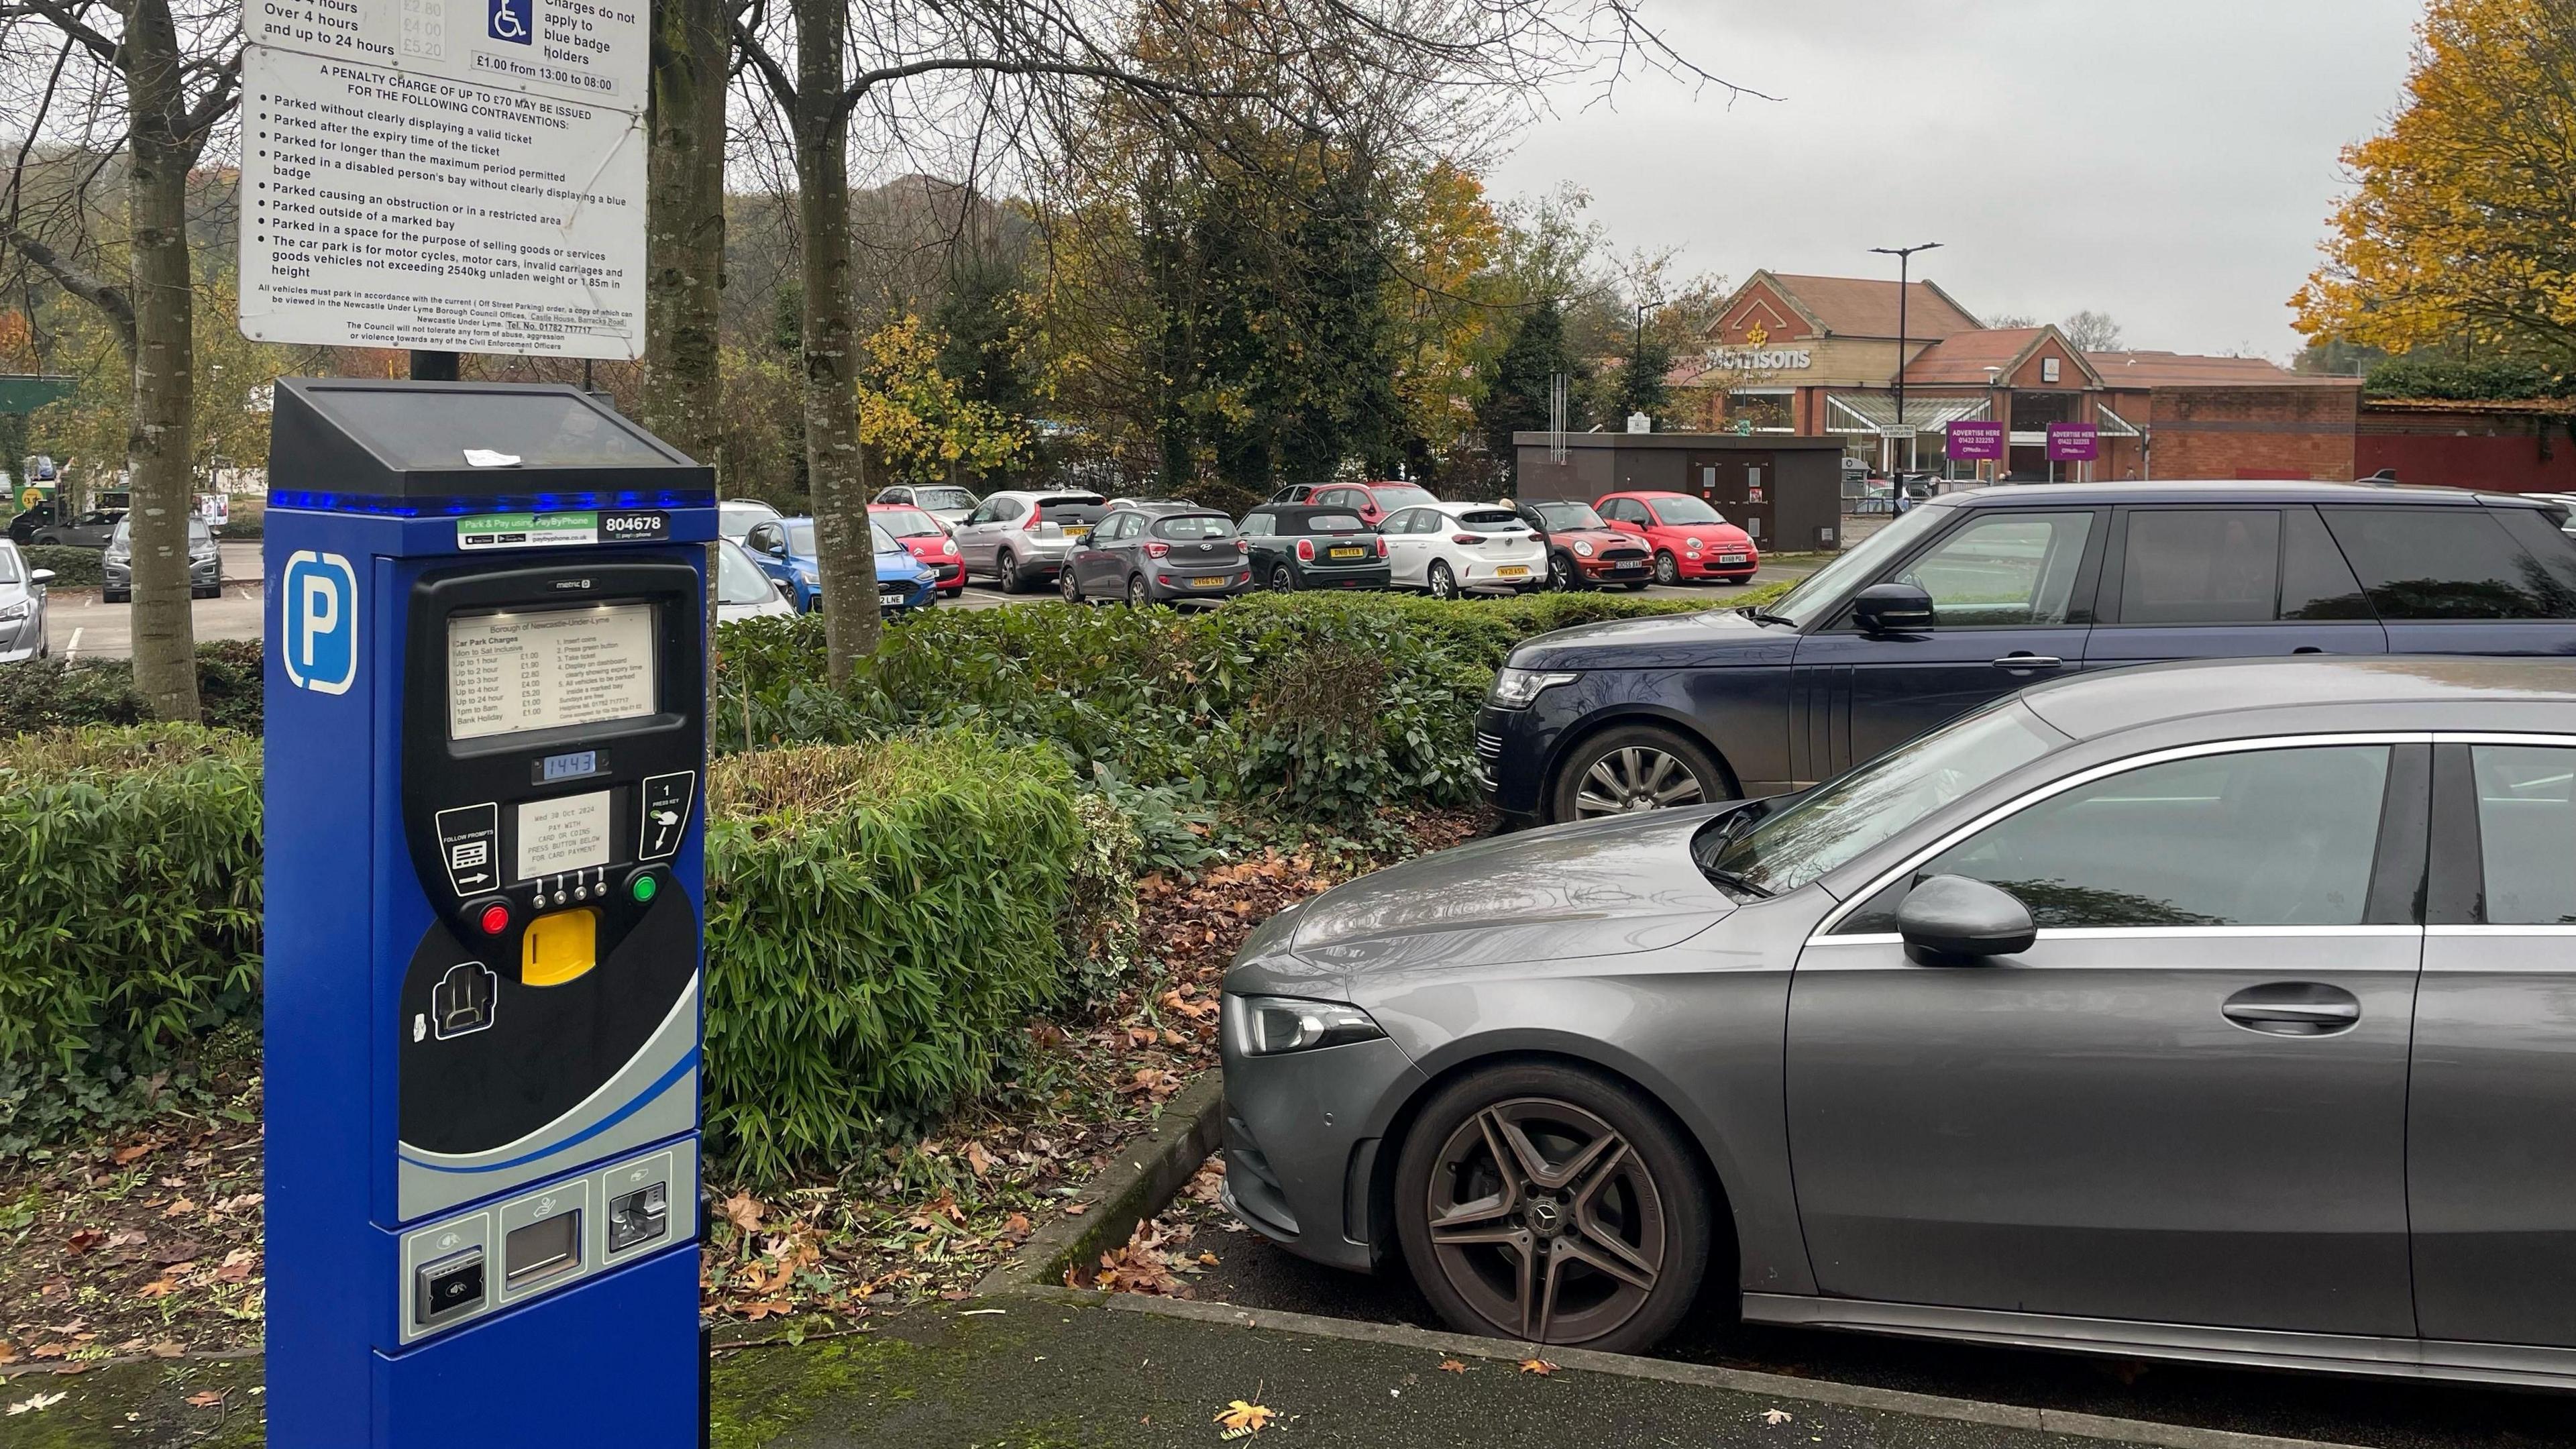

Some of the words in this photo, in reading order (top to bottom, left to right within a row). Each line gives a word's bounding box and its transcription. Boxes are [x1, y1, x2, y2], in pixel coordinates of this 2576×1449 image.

[265, 3, 299, 19] Over
[305, 11, 313, 22] 4
[319, 13, 358, 31] hours
[545, 13, 578, 30] apply
[582, 19, 592, 31] to
[599, 7, 613, 19] do
[617, 13, 635, 24] not
[265, 23, 290, 36] and
[296, 29, 313, 42] up
[317, 31, 331, 43] to
[335, 34, 352, 48] 24
[357, 38, 394, 55] hours
[545, 28, 570, 44] blue
[574, 34, 610, 52] badge
[545, 45, 589, 64] holders
[477, 56, 506, 70] £1.00
[510, 62, 535, 76] from
[539, 68, 568, 82] 13:00
[571, 74, 581, 85] to
[584, 76, 611, 90] 08:00
[321, 65, 328, 74] A
[333, 67, 385, 85] PENALTY
[389, 77, 437, 93] CHARGE
[440, 86, 455, 96] OF
[459, 89, 472, 99] UP
[476, 92, 490, 103] TO
[494, 95, 511, 106] £70
[515, 99, 536, 110] MAY
[539, 103, 552, 113] BE
[556, 106, 591, 119] ISSUED
[348, 84, 372, 97] FOR
[376, 89, 398, 101] THE
[402, 93, 468, 113] FOLLOWING
[472, 105, 568, 129] CONTRAVENTIONS:
[275, 95, 316, 110] Parked
[321, 104, 364, 118] without
[368, 111, 405, 127] clearly
[409, 117, 464, 136] displaying
[477, 129, 501, 140] valid
[504, 132, 531, 144] ticket
[274, 114, 316, 129] Parked
[321, 122, 347, 133] after
[352, 126, 369, 137] the
[373, 131, 407, 145] expiry
[411, 135, 434, 146] time
[437, 140, 448, 148] of
[451, 141, 468, 152] the
[472, 144, 499, 156] ticket
[274, 133, 316, 148] Parked
[320, 139, 337, 150] for
[341, 142, 377, 157] longer
[381, 148, 405, 160] than
[409, 152, 426, 162] the
[430, 157, 479, 170] maximum
[484, 164, 515, 175] period
[519, 170, 565, 182] permitted
[273, 201, 315, 214] Parked
[319, 207, 362, 219] outside
[366, 211, 378, 221] of
[392, 215, 432, 227] marked
[436, 219, 455, 230] bay
[417, 315, 455, 325] Newcastle
[539, 323, 563, 333] 01782
[565, 325, 591, 335] 717717
[465, 520, 484, 529] Park
[494, 519, 510, 529] Pay
[511, 519, 535, 528] using
[606, 517, 661, 531] 804678
[555, 581, 582, 589] metric
[490, 625, 521, 633] Borough
[521, 652, 539, 660] £1.00
[458, 716, 476, 724] Bank
[477, 714, 503, 722] Holiday
[523, 708, 541, 716] £1.00
[550, 755, 592, 775] 1443
[663, 785, 669, 796] 1
[579, 806, 594, 814] 2024
[443, 834, 467, 843] FOLLOW
[468, 829, 494, 839] PROMPTS
[538, 834, 555, 843] CARD
[570, 828, 590, 837] COINS
[548, 824, 561, 832] PAY
[528, 844, 549, 853] PRESS
[552, 840, 576, 849] BUTTON
[580, 836, 600, 845] BELOW
[548, 851, 565, 859] CARD
[568, 845, 596, 855] PAYMENT
